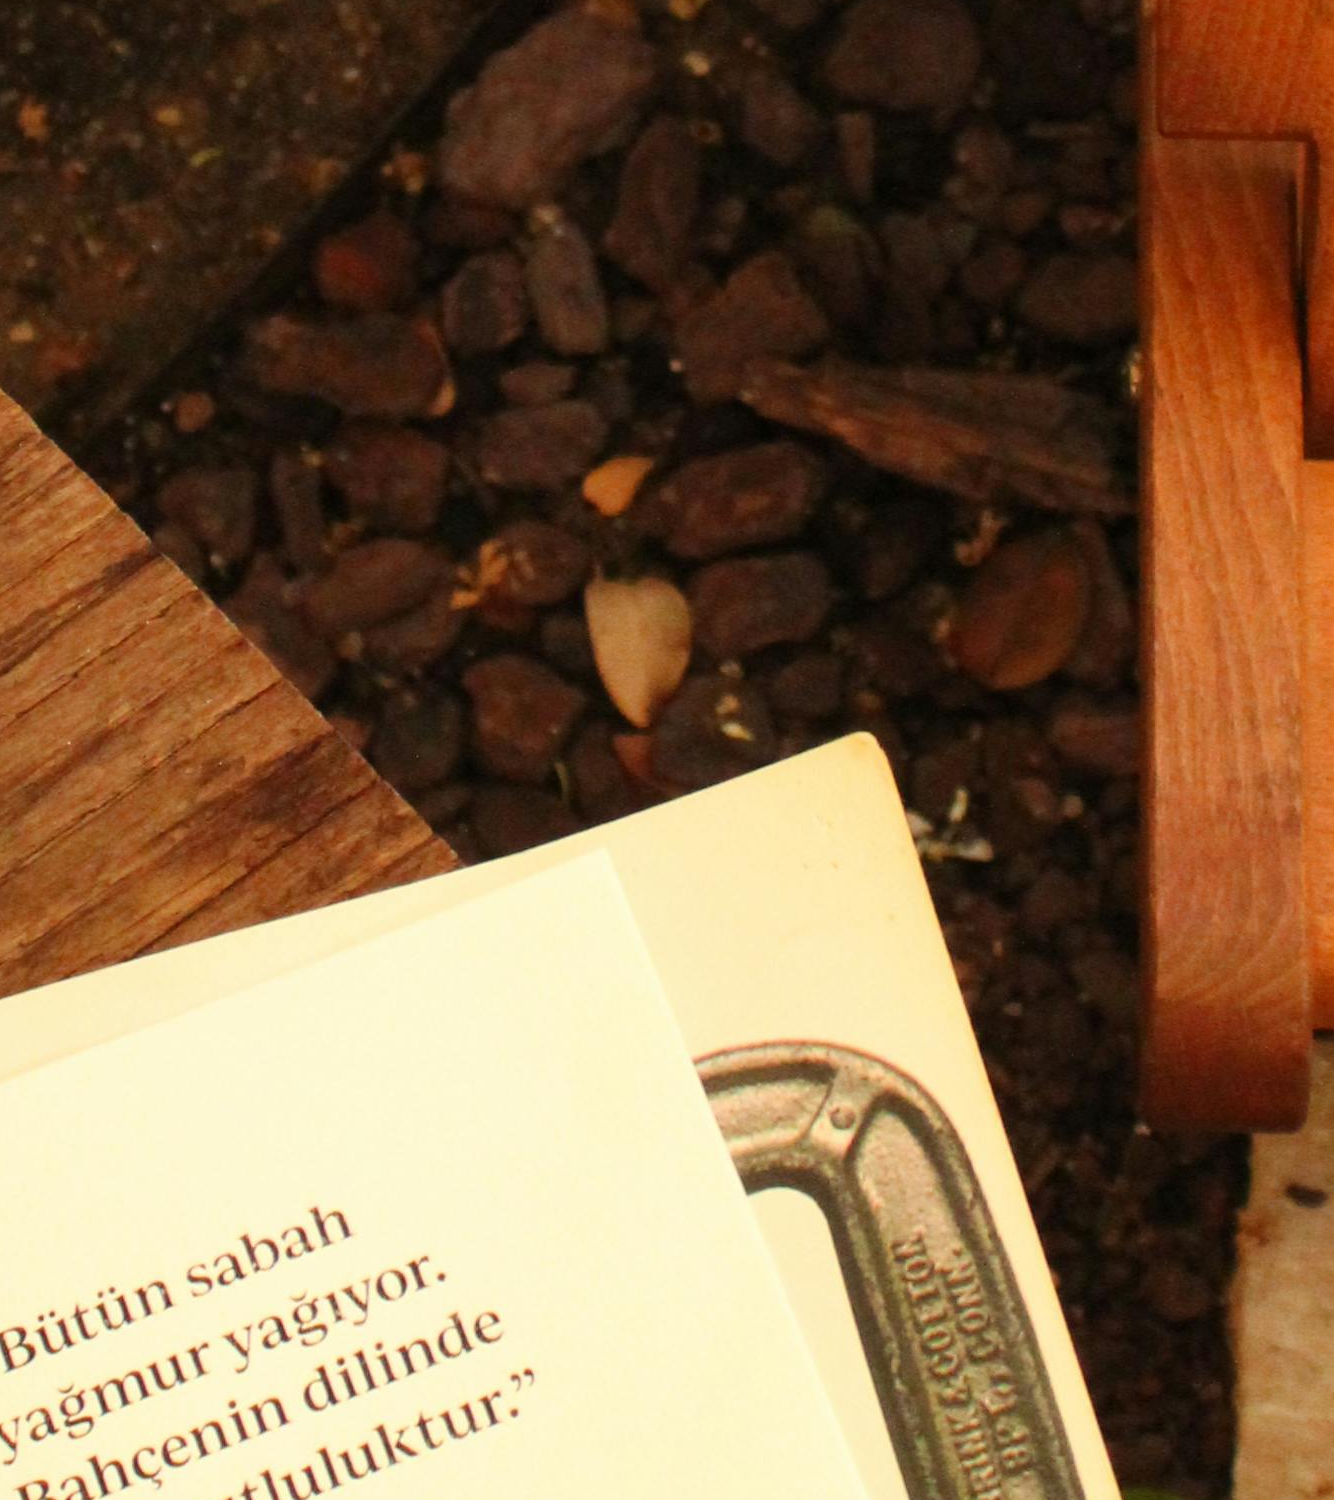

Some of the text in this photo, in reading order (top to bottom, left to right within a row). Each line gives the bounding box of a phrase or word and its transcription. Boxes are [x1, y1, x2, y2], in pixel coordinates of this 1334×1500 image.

[187, 1206, 354, 1298] sabah
[223, 1251, 447, 1373] yağıyor.
[303, 1310, 504, 1413] dilinde
